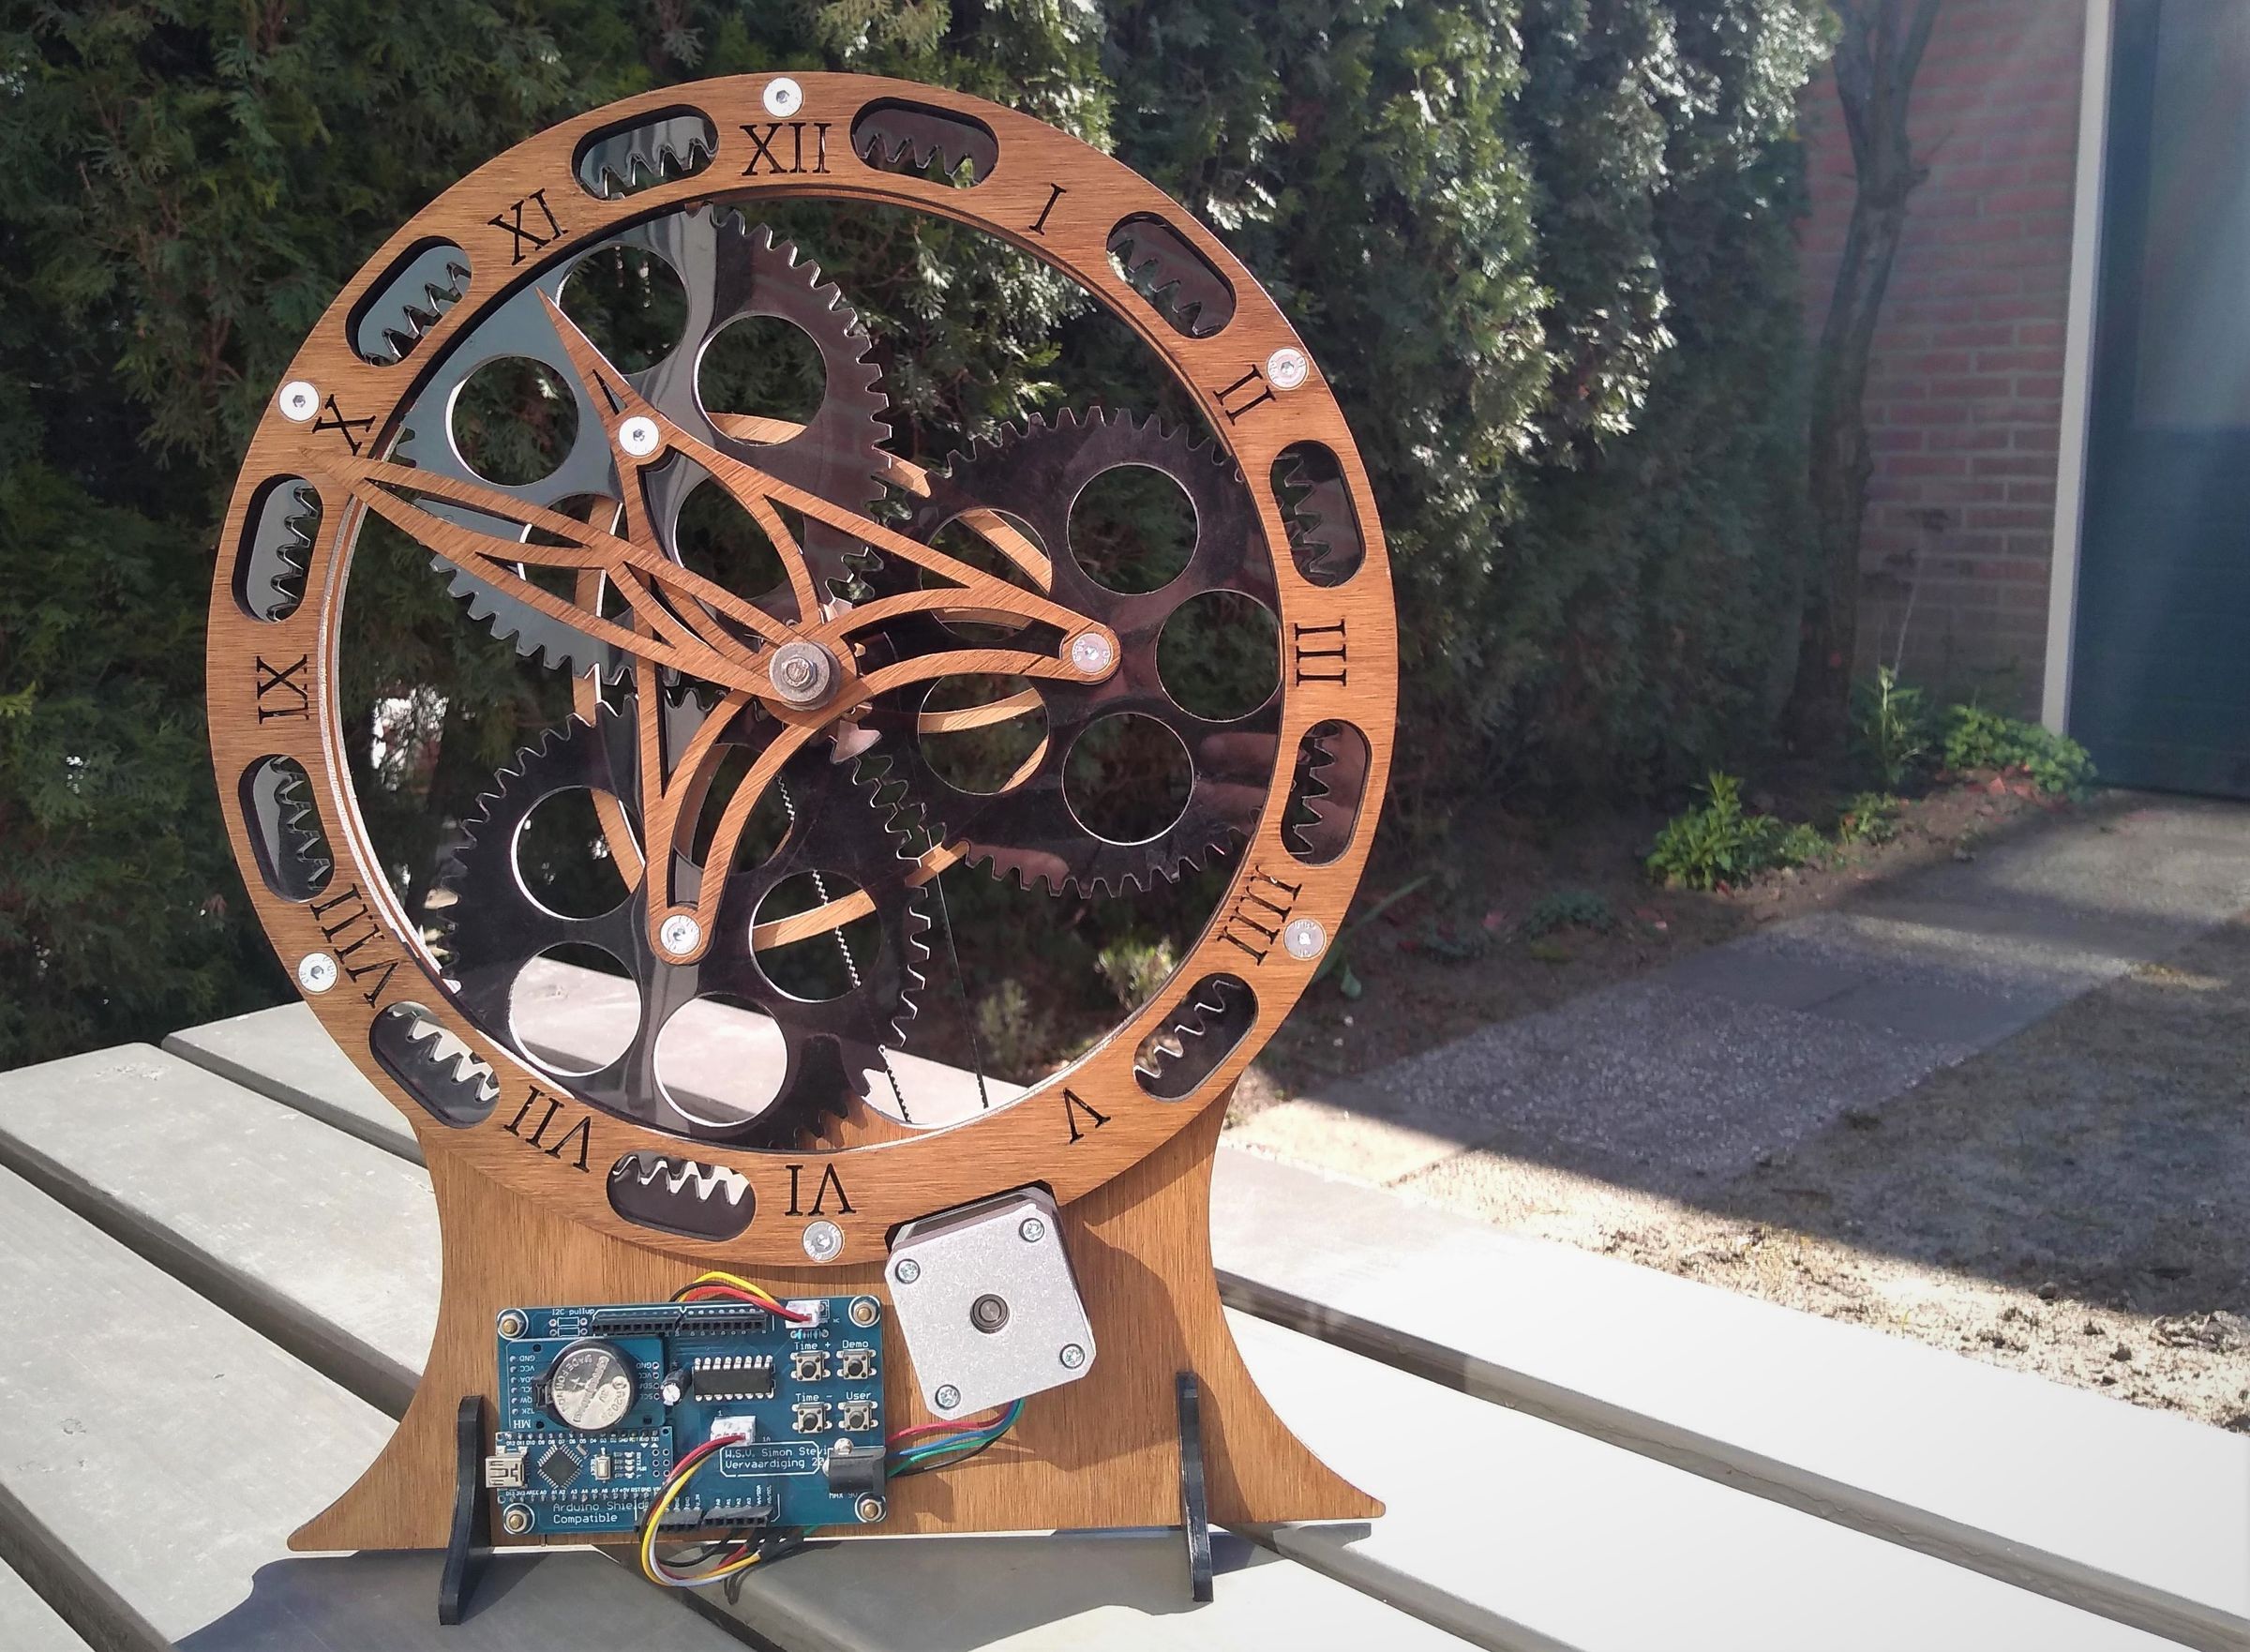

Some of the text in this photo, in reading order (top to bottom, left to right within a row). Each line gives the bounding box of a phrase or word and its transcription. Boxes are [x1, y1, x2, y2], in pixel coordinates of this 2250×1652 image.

[739, 122, 832, 176] XII
[487, 188, 568, 266] XI
[1028, 182, 1068, 236] I
[1212, 363, 1277, 427] II
[311, 393, 376, 458] X
[1294, 618, 1347, 687] III
[255, 653, 309, 725] IX
[1216, 864, 1302, 967] IIII
[309, 883, 399, 1009] VIII
[502, 1085, 594, 1174] VII
[1061, 1086, 1112, 1145] V
[784, 1163, 857, 1217] VI
[568, 1307, 595, 1316] pullup
[793, 1341, 818, 1350] Time
[842, 1340, 869, 1348] Demo
[795, 1392, 820, 1402] Time
[846, 1391, 872, 1400] User
[513, 1419, 532, 1429] MH
[761, 1449, 793, 1457] Simon
[799, 1445, 827, 1456] Stevi
[725, 1460, 805, 1470] Vervaardiging
[553, 1503, 600, 1511] Arduino
[553, 1512, 618, 1525] Compatible
